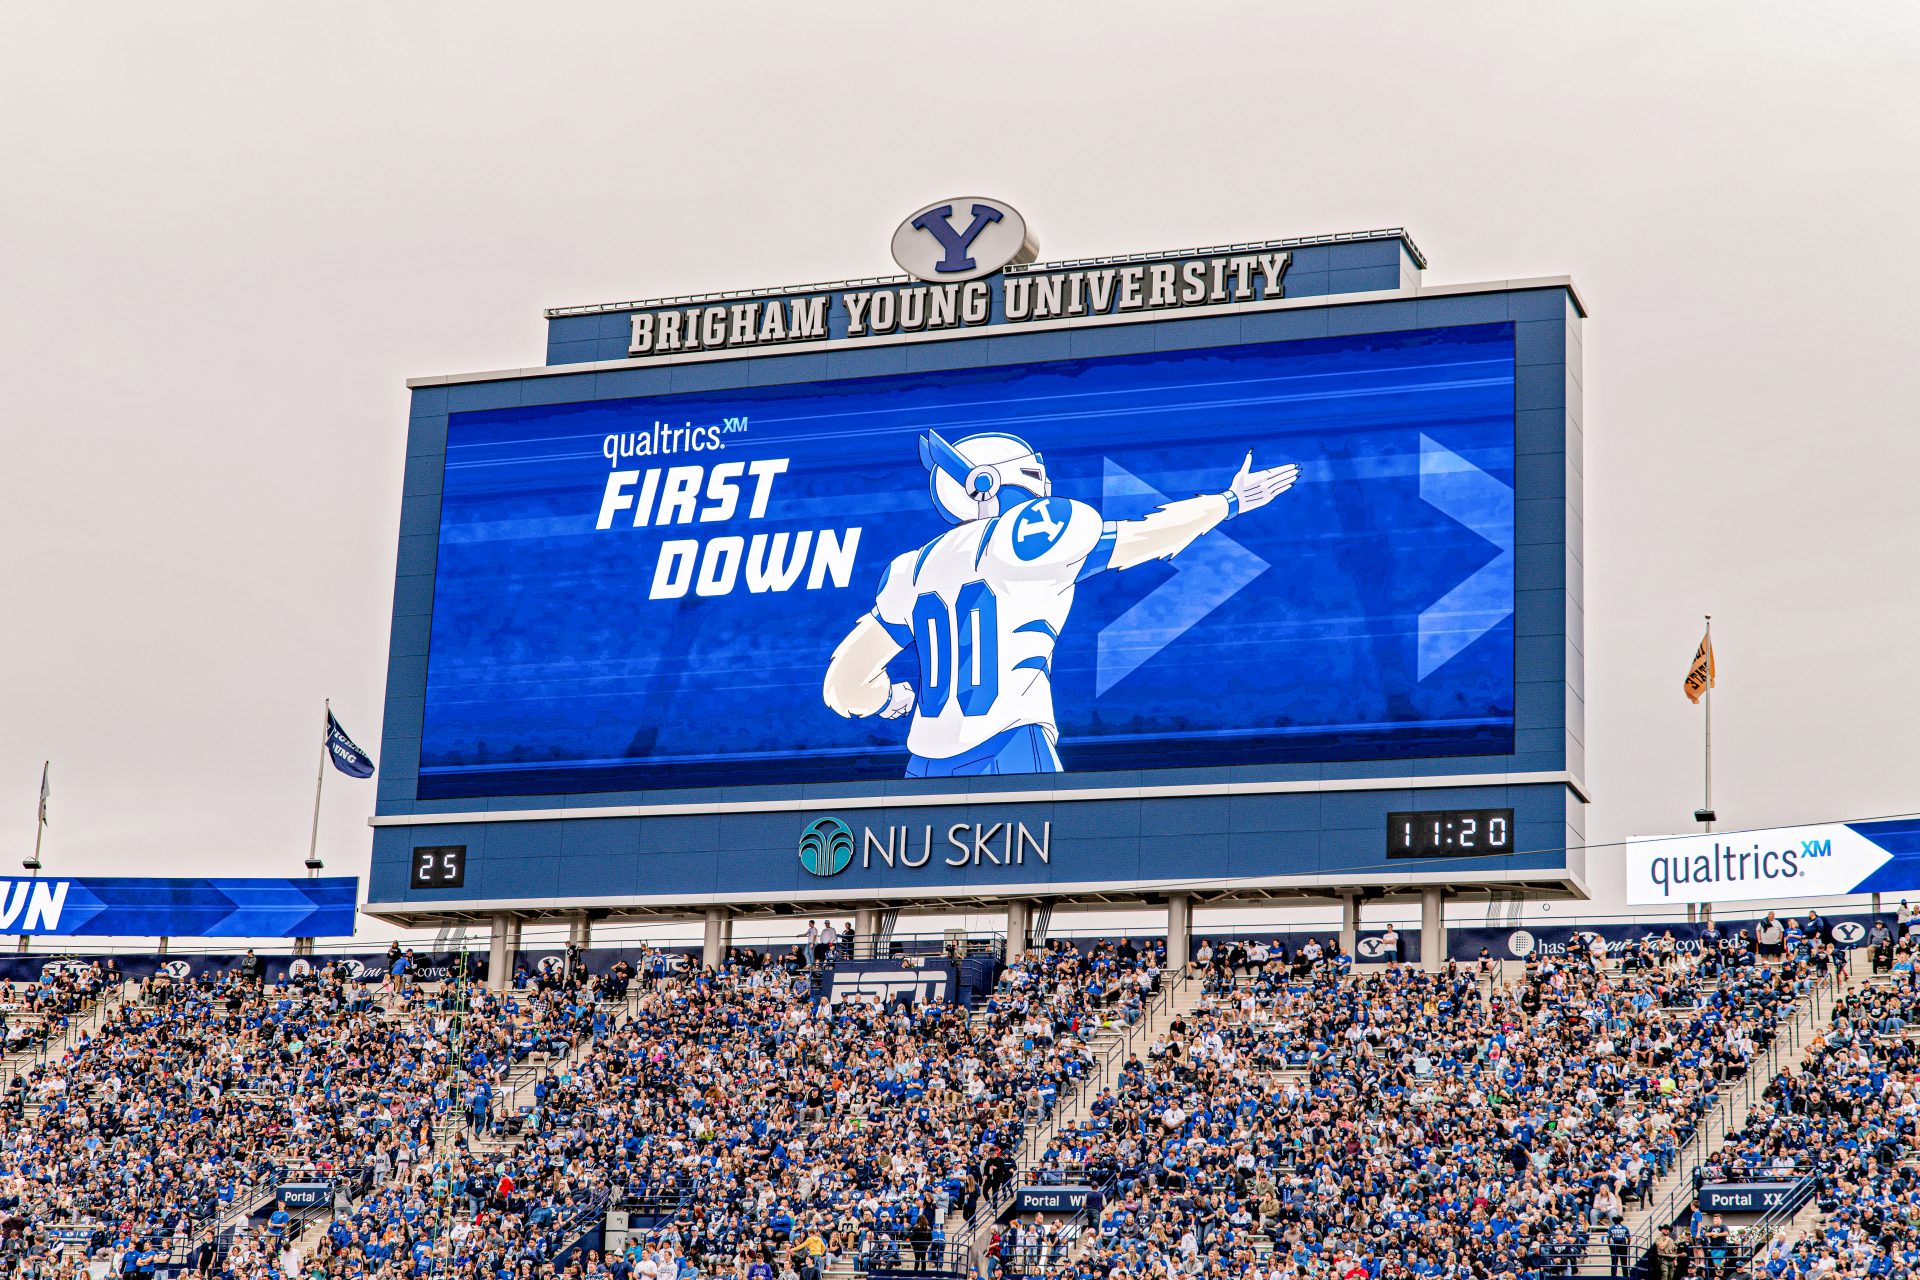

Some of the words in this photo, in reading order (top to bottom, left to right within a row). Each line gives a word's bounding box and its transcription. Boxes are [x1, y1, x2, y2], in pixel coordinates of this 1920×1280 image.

[910, 203, 1004, 273] Y
[628, 294, 829, 355] BRIGHAM
[844, 280, 990, 337] YOUNG
[1001, 251, 1293, 322] UNIVERSITY
[595, 458, 790, 530] FIRST
[648, 527, 862, 600] DOWN
[862, 825, 932, 868] NU
[945, 821, 1050, 868] SKIN
[1405, 818, 1507, 847] 11:20
[1800, 839, 1832, 858] XM
[419, 854, 457, 880] 25
[1538, 938, 1566, 954] has
[284, 1191, 315, 1203] Portal
[1023, 1195, 1060, 1207] Portal
[1711, 1193, 1752, 1207] Portal
[1763, 1193, 1784, 1206] XX
